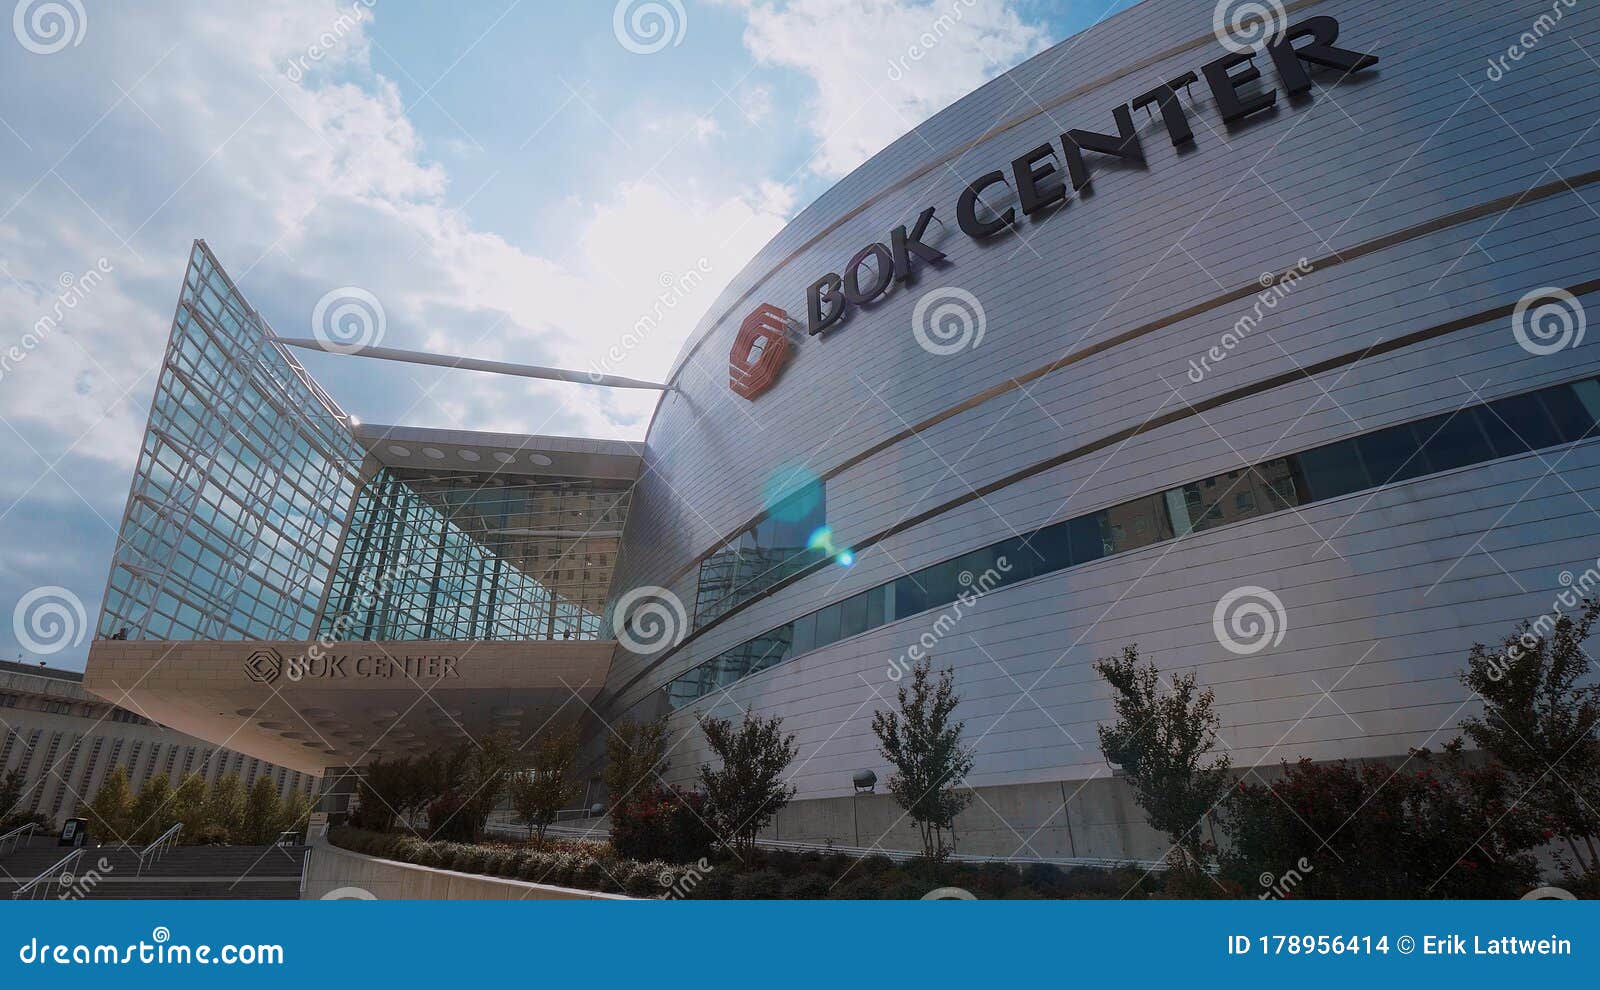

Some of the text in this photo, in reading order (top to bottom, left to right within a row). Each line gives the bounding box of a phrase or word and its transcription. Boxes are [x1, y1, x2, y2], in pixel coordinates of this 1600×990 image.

[806, 15, 1380, 337] BOK CENTER
[355, 655, 462, 679] CENTER
